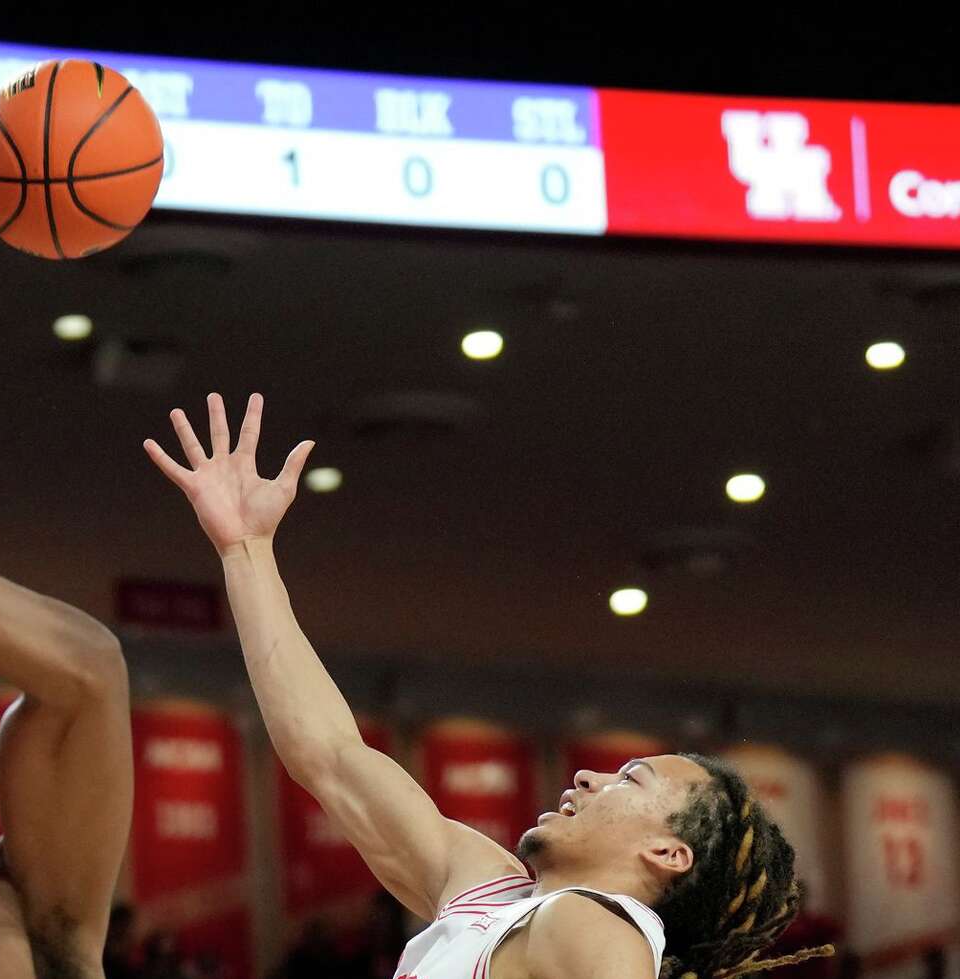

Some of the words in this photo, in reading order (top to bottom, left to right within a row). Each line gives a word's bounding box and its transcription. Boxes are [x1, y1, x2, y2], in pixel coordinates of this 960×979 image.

[281, 151, 301, 187] 1
[404, 156, 434, 198] 0
[541, 163, 570, 205] 0
